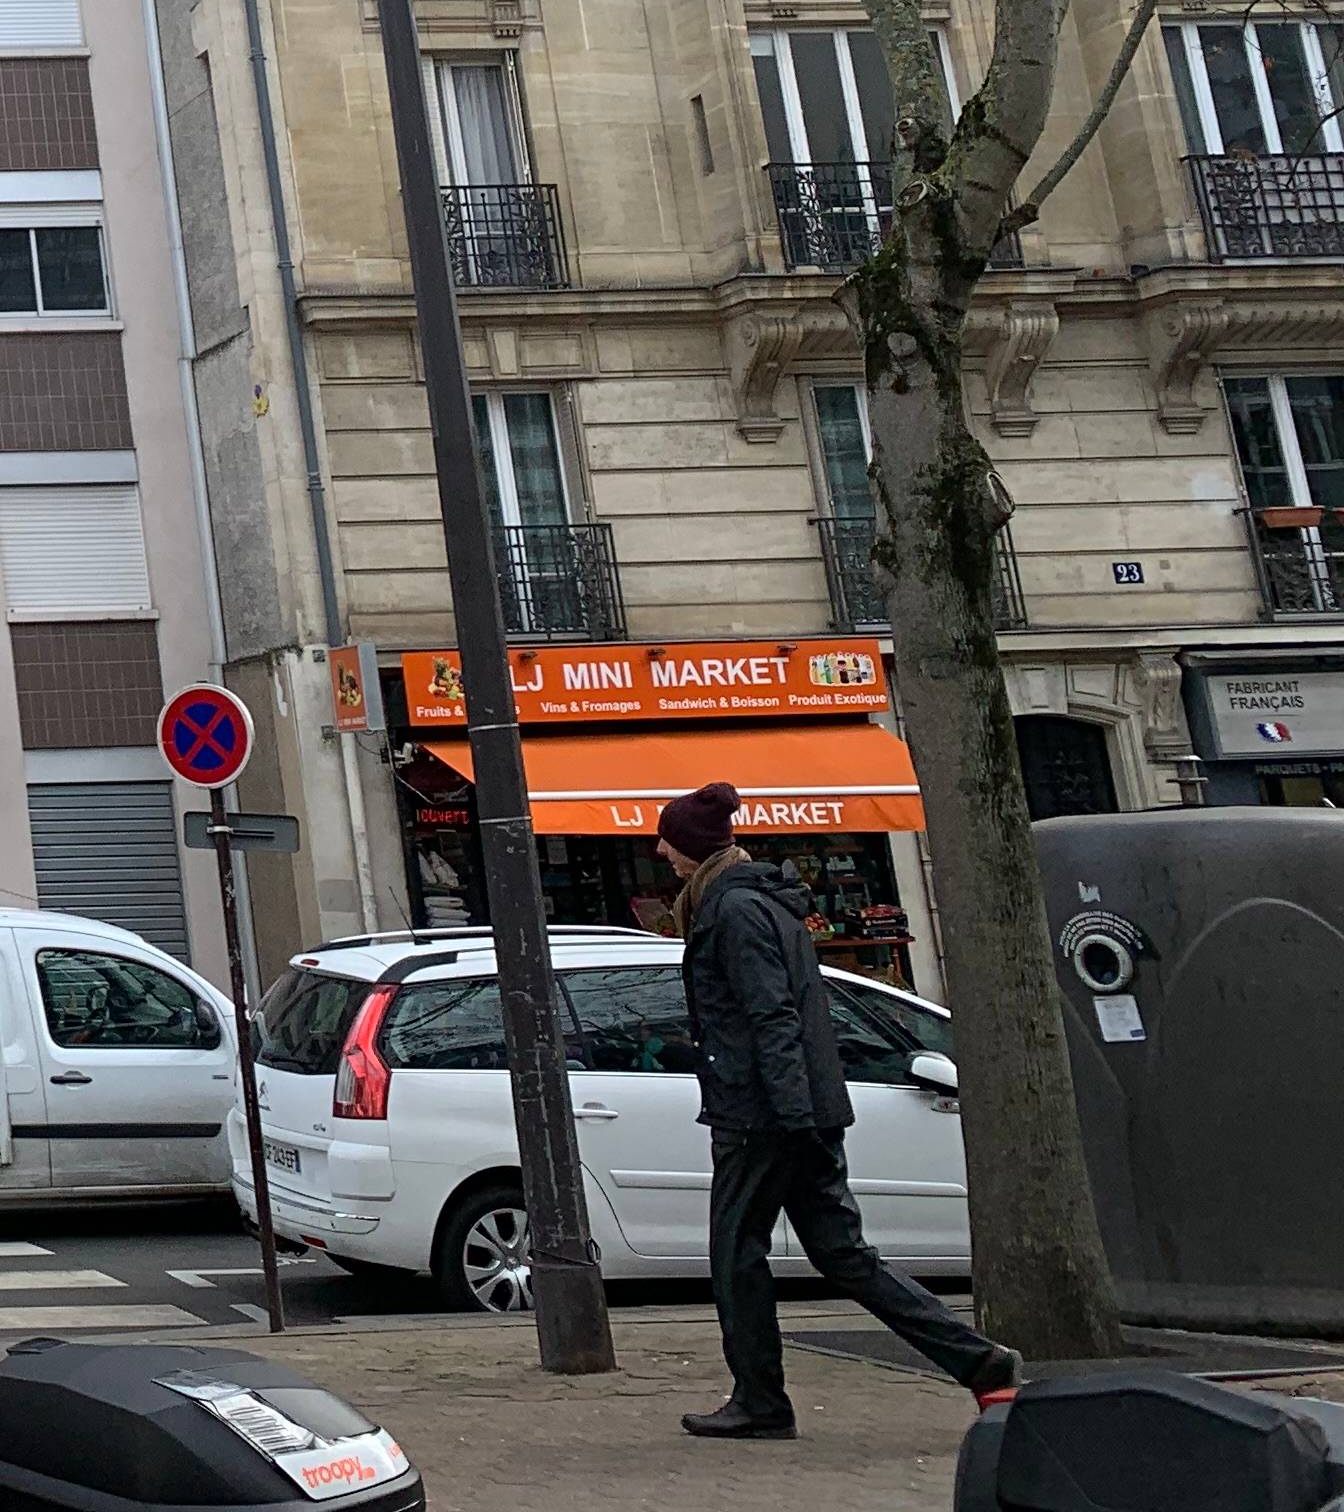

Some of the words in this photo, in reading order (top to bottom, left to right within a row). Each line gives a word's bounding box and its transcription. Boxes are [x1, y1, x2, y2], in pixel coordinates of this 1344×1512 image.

[1116, 564, 1140, 582] 23
[510, 664, 544, 692] LJ
[563, 661, 633, 690] MINI
[650, 657, 789, 687] MARKET
[1226, 681, 1299, 694] FABRICANT
[540, 702, 567, 713] Vins
[570, 701, 579, 713] &
[582, 700, 641, 714] Fromages
[659, 697, 716, 710] Sandwich
[719, 697, 729, 708] &
[731, 695, 780, 708] Boisson
[788, 693, 833, 706] Produit
[834, 692, 887, 706] Exotique
[1229, 695, 1304, 712] FRANÇAIS
[416, 705, 451, 718] Fruits
[609, 805, 644, 827] LJ
[731, 802, 845, 827] MARKET
[302, 1456, 362, 1488] troopy
